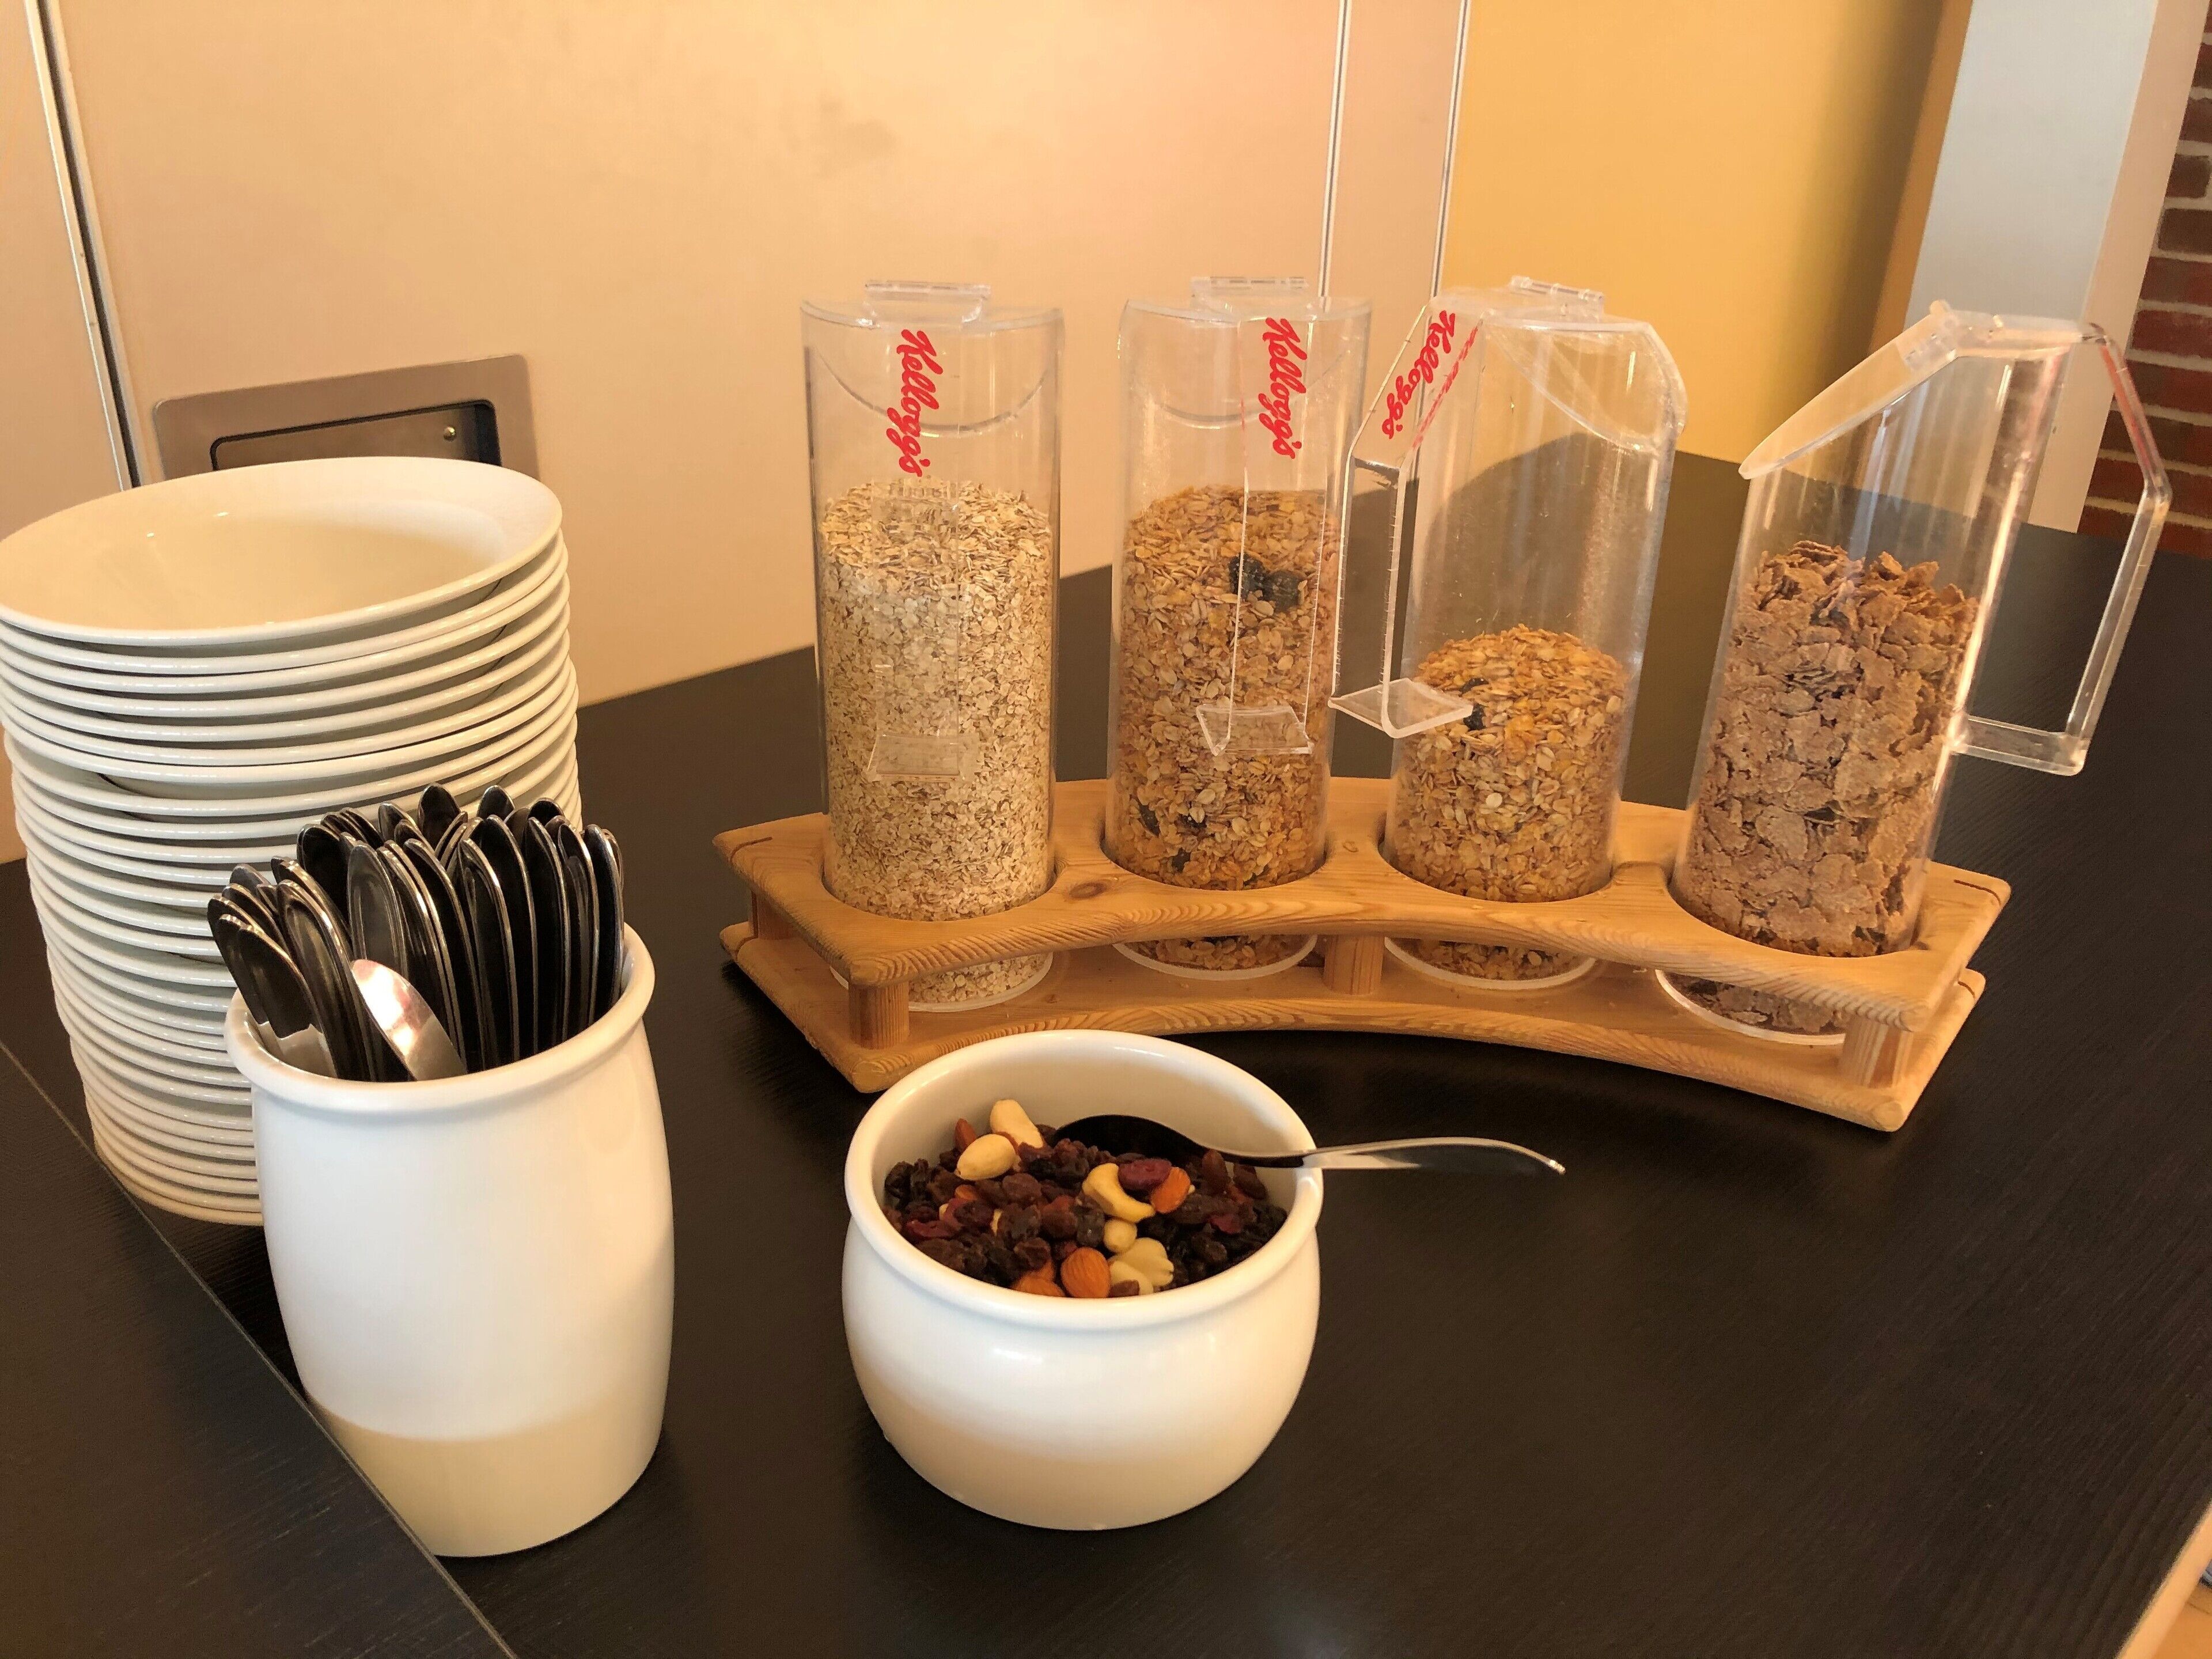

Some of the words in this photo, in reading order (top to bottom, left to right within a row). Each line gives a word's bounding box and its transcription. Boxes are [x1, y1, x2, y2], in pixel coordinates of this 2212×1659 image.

[886, 329, 944, 477] Kellogg's
[1257, 317, 1307, 459] Kellogg's
[1381, 310, 1456, 440] Kellogg's
